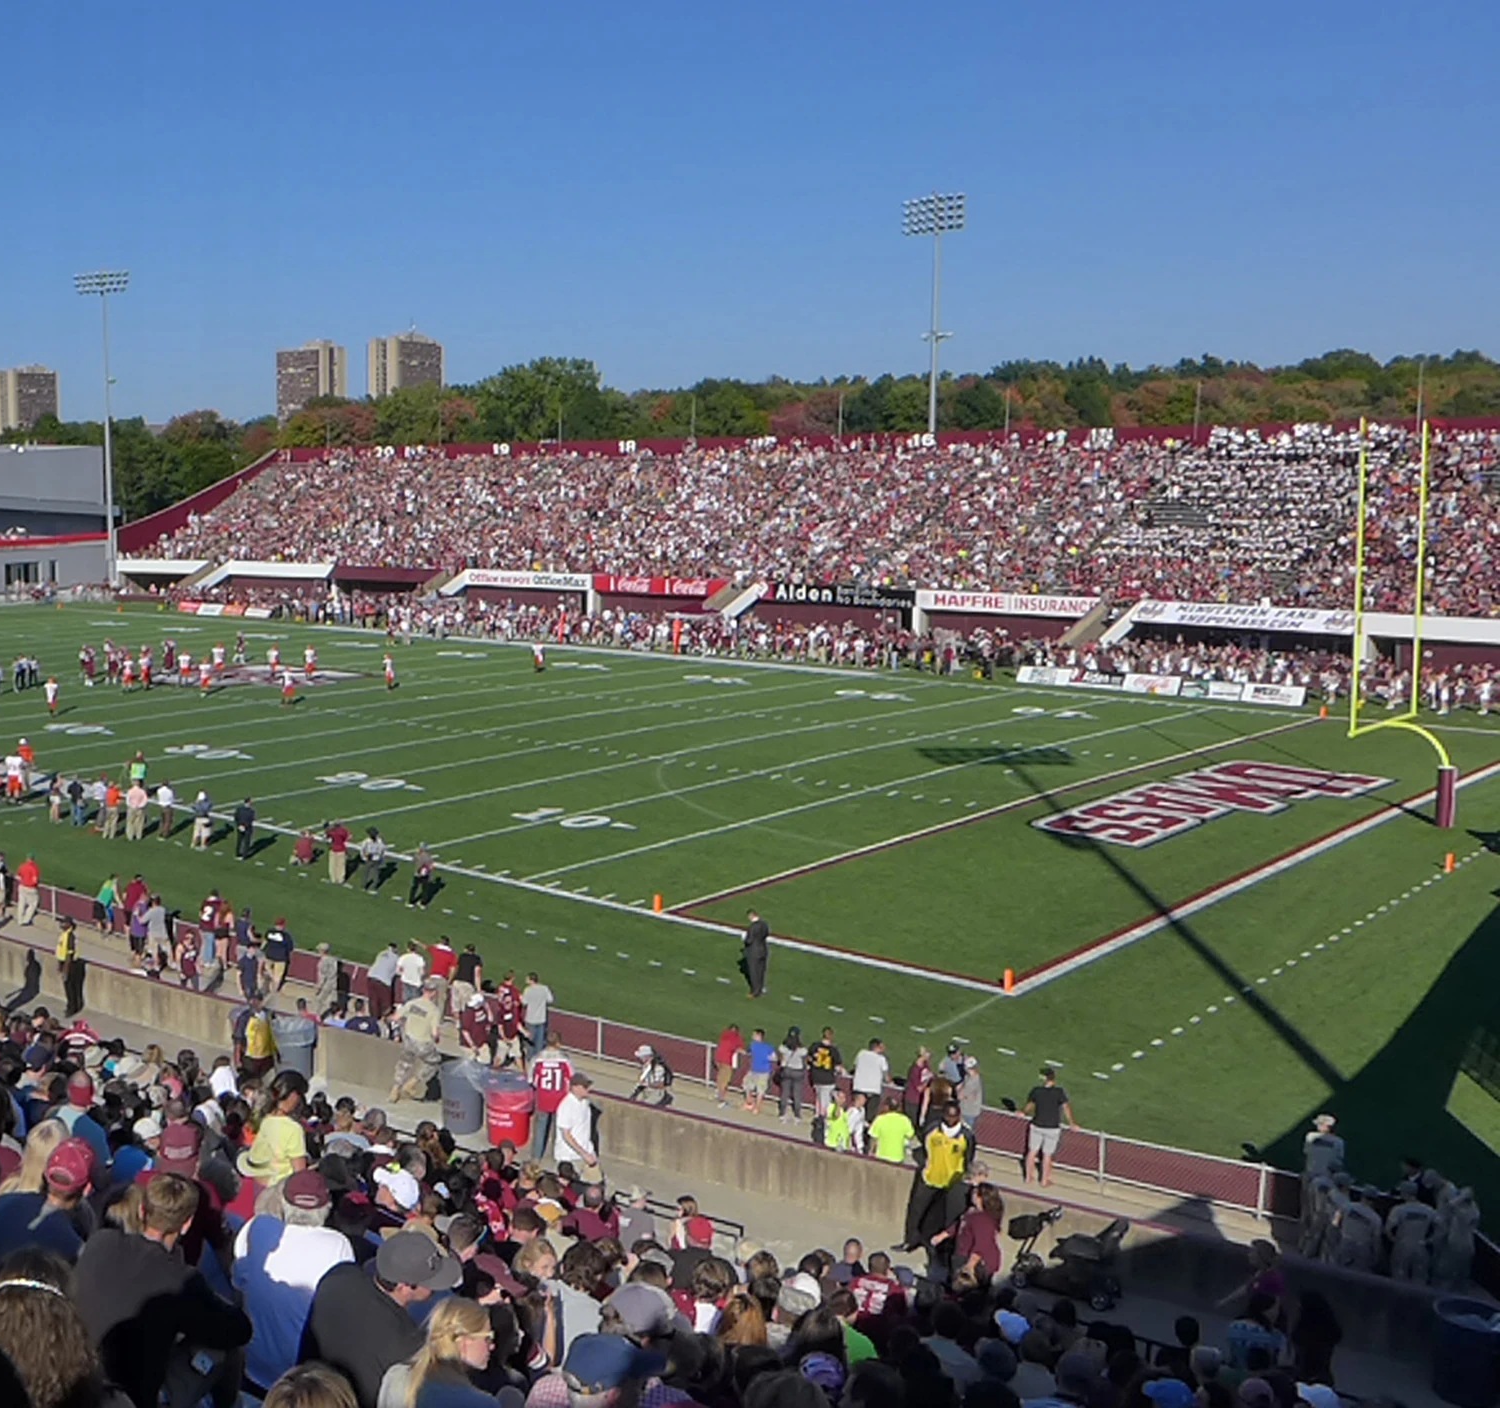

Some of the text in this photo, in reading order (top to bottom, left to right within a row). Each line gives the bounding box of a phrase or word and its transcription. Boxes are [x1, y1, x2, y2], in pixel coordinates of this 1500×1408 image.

[374, 445, 395, 458] 20
[492, 443, 510, 455] 19
[618, 440, 636, 453] 18
[532, 574, 588, 587] OfficeMax
[776, 583, 833, 602] Alden
[934, 593, 1004, 609] MAPFRE
[1175, 604, 1318, 619] MINUTEMAN FANS
[1032, 760, 1395, 848] UMASS
[510, 807, 612, 829] 10
[541, 1068, 562, 1091] 21
